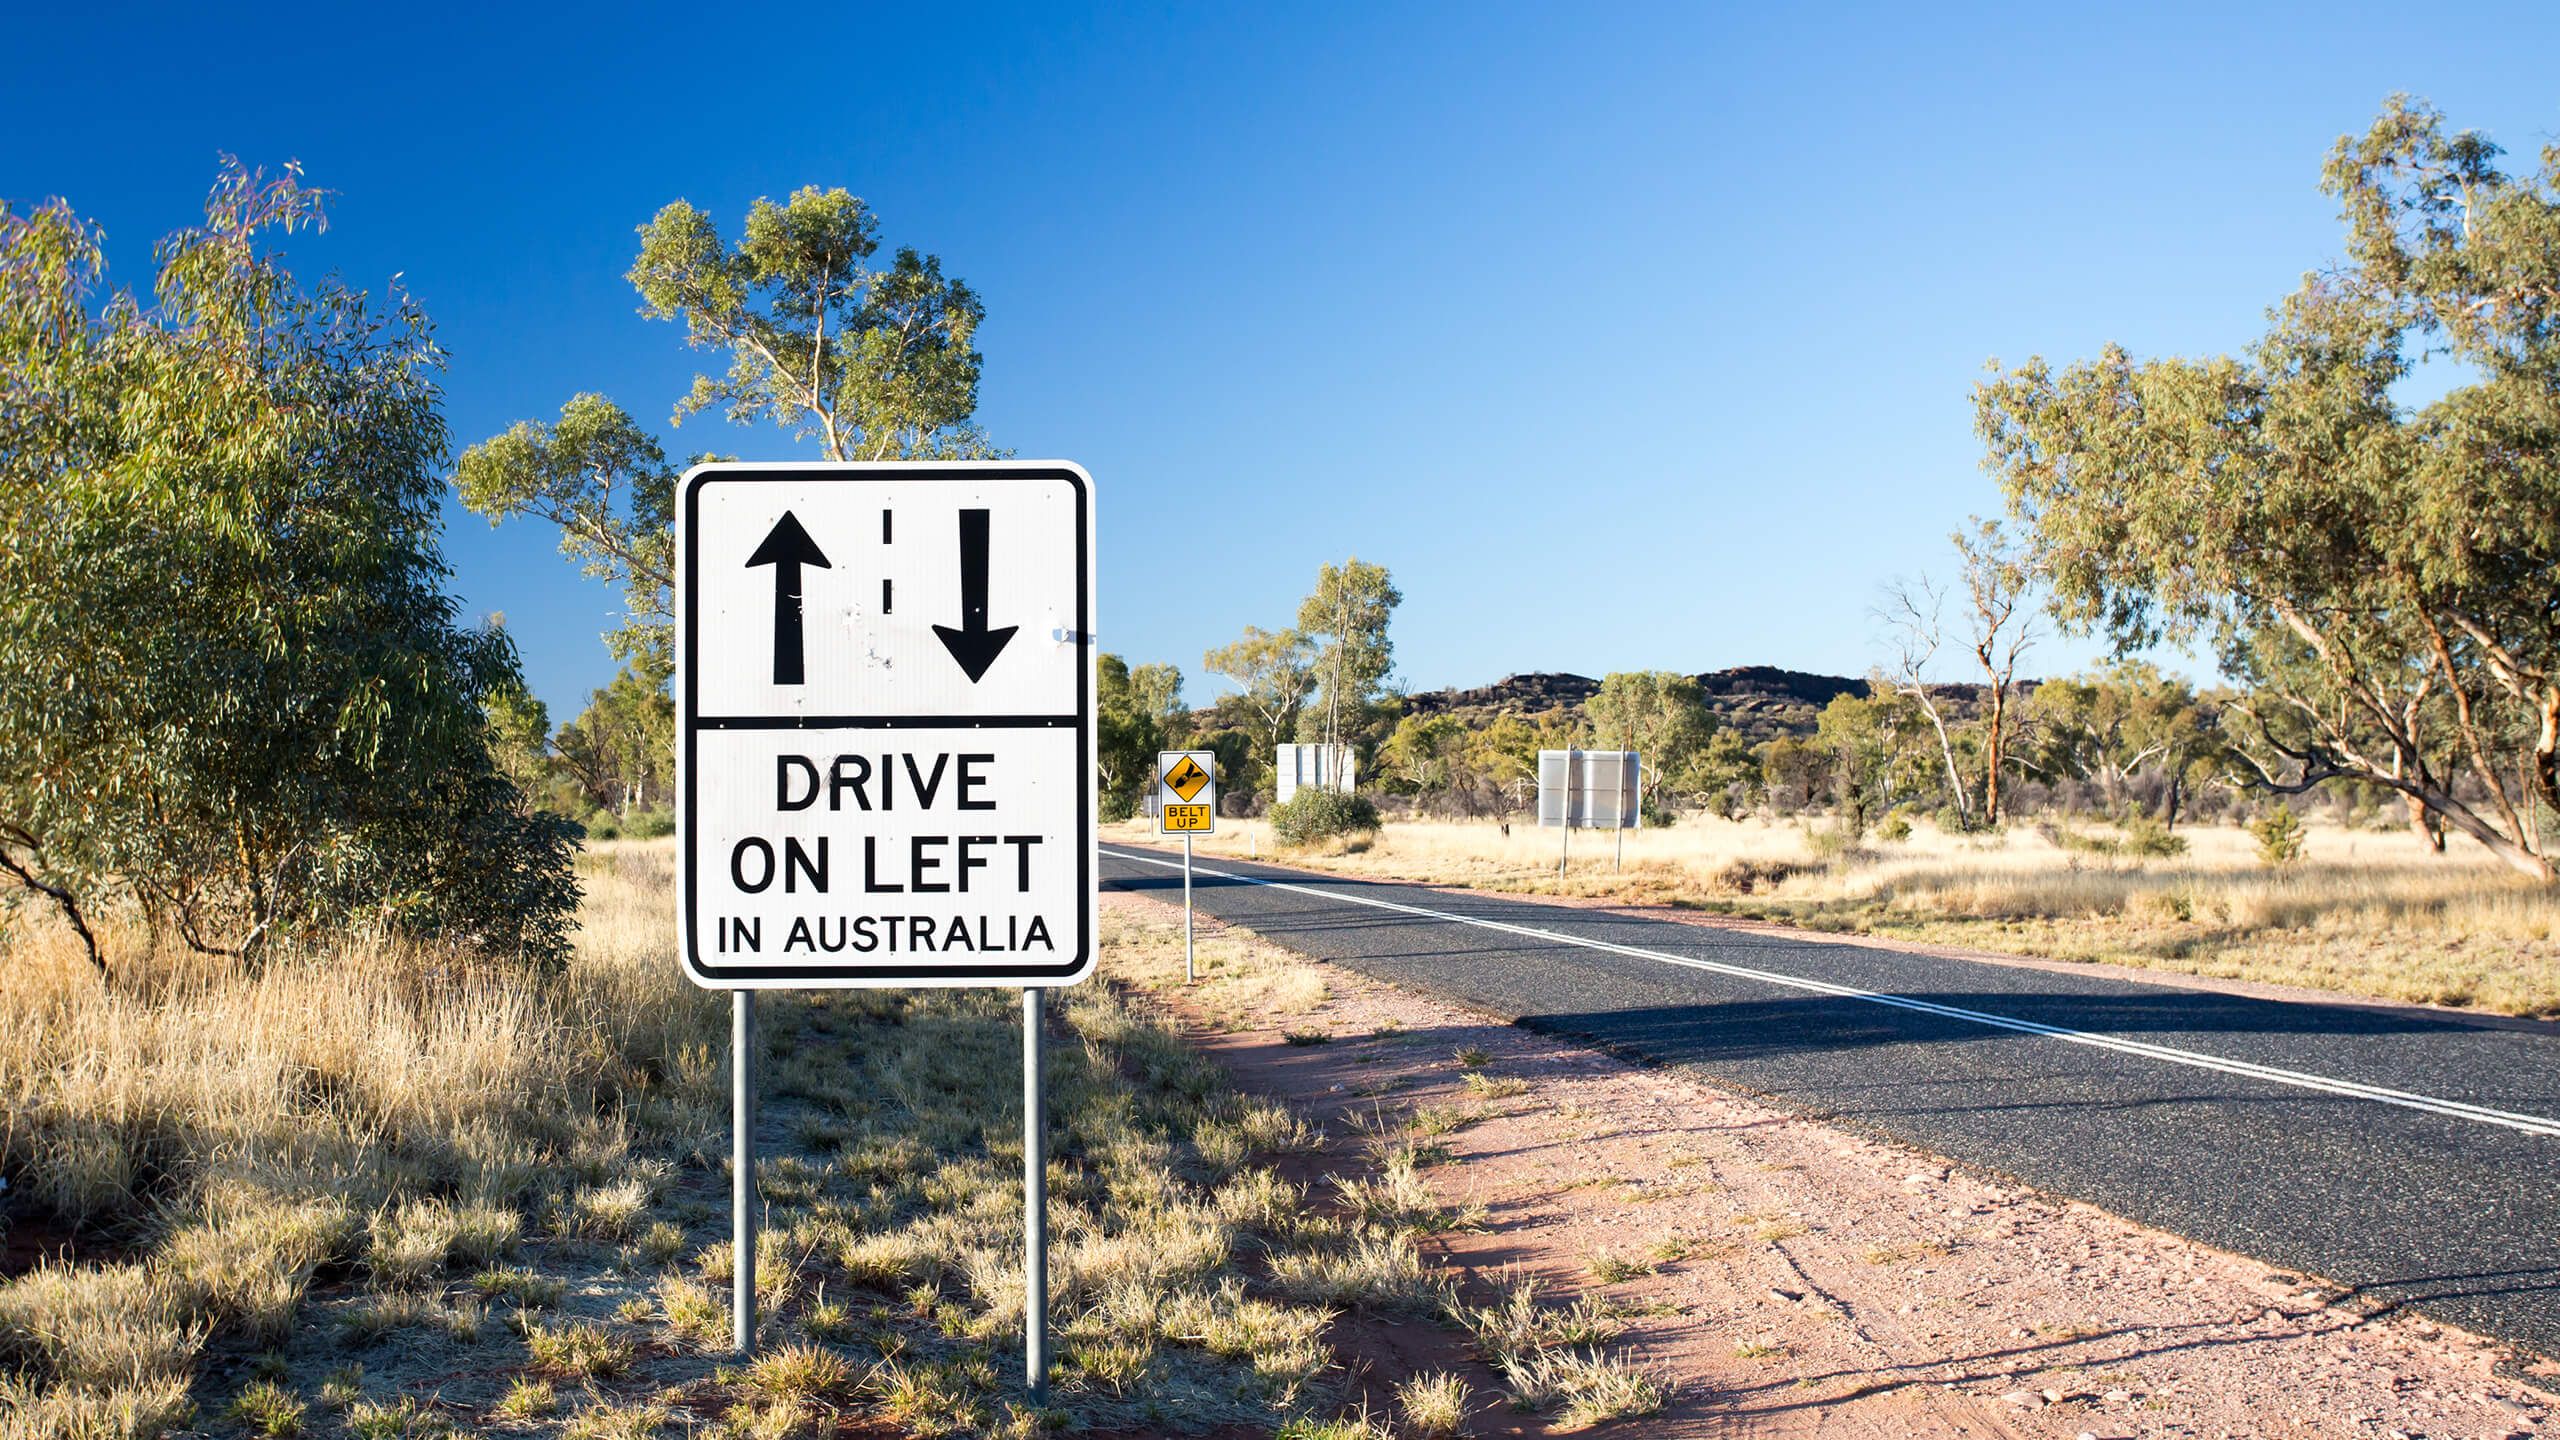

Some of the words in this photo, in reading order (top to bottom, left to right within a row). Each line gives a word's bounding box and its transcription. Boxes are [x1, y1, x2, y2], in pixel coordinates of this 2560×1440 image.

[776, 753, 997, 812] DRIVE
[1168, 806, 1206, 817] BELT
[1176, 818, 1199, 829] UP
[730, 836, 829, 894] ON
[864, 835, 1043, 893] LEFT
[718, 916, 761, 953] IN
[783, 915, 1055, 953] AUSTRALIA
